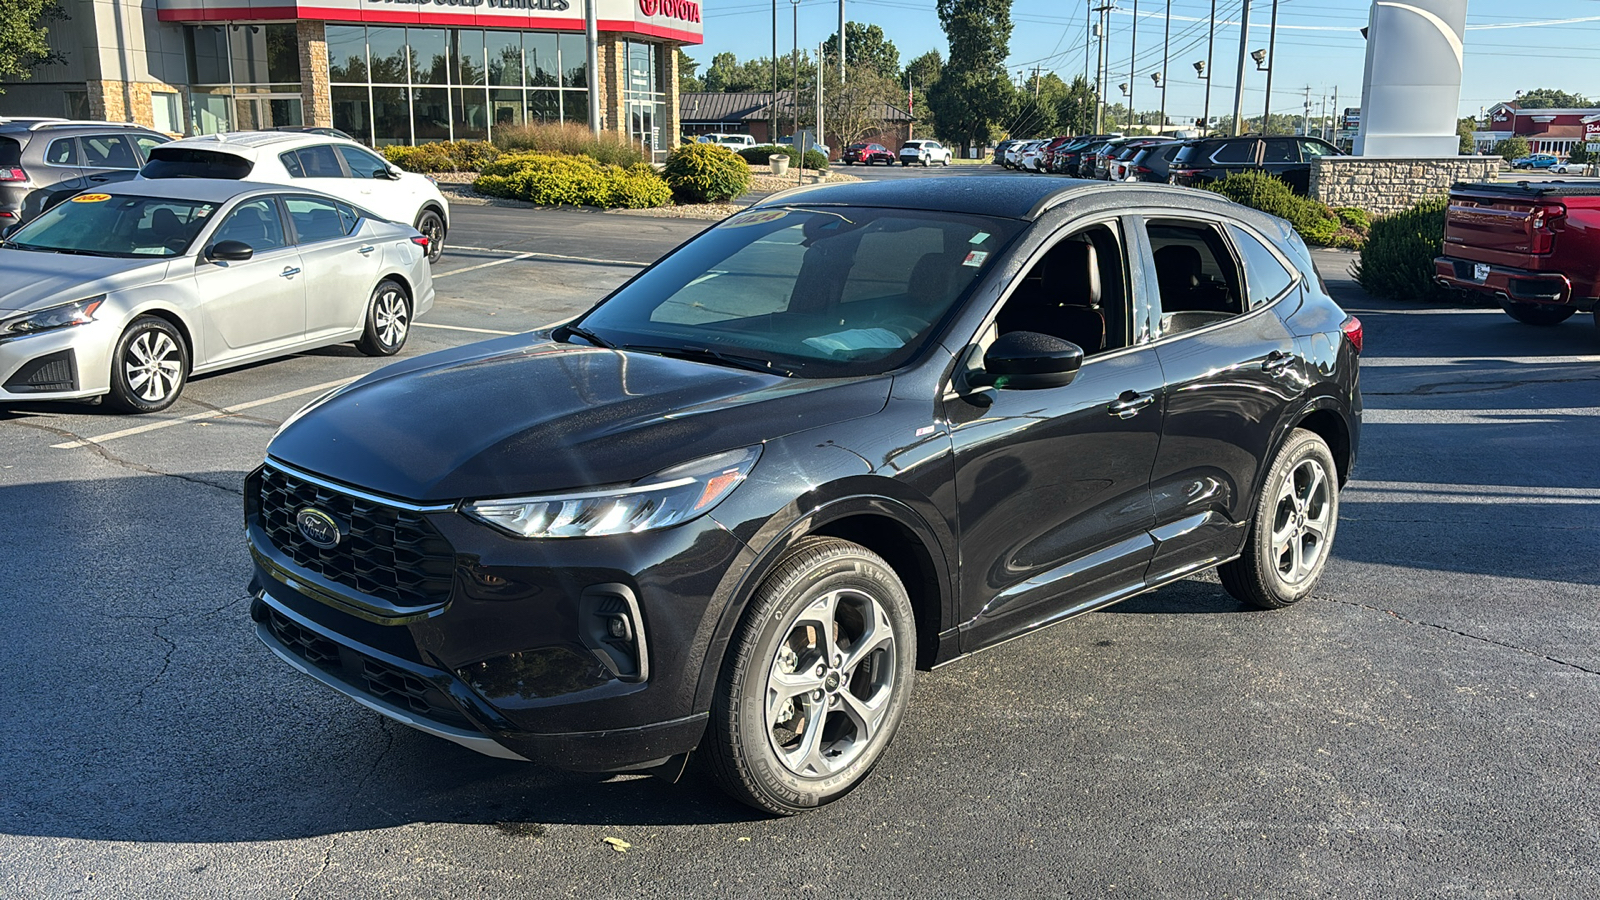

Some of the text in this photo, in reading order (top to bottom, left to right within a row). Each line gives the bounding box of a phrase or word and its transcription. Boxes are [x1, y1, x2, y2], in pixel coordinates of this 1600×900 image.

[659, 0, 700, 23] TOYOTA
[303, 515, 327, 540] Ford
[757, 760, 800, 803] MICHELIN
